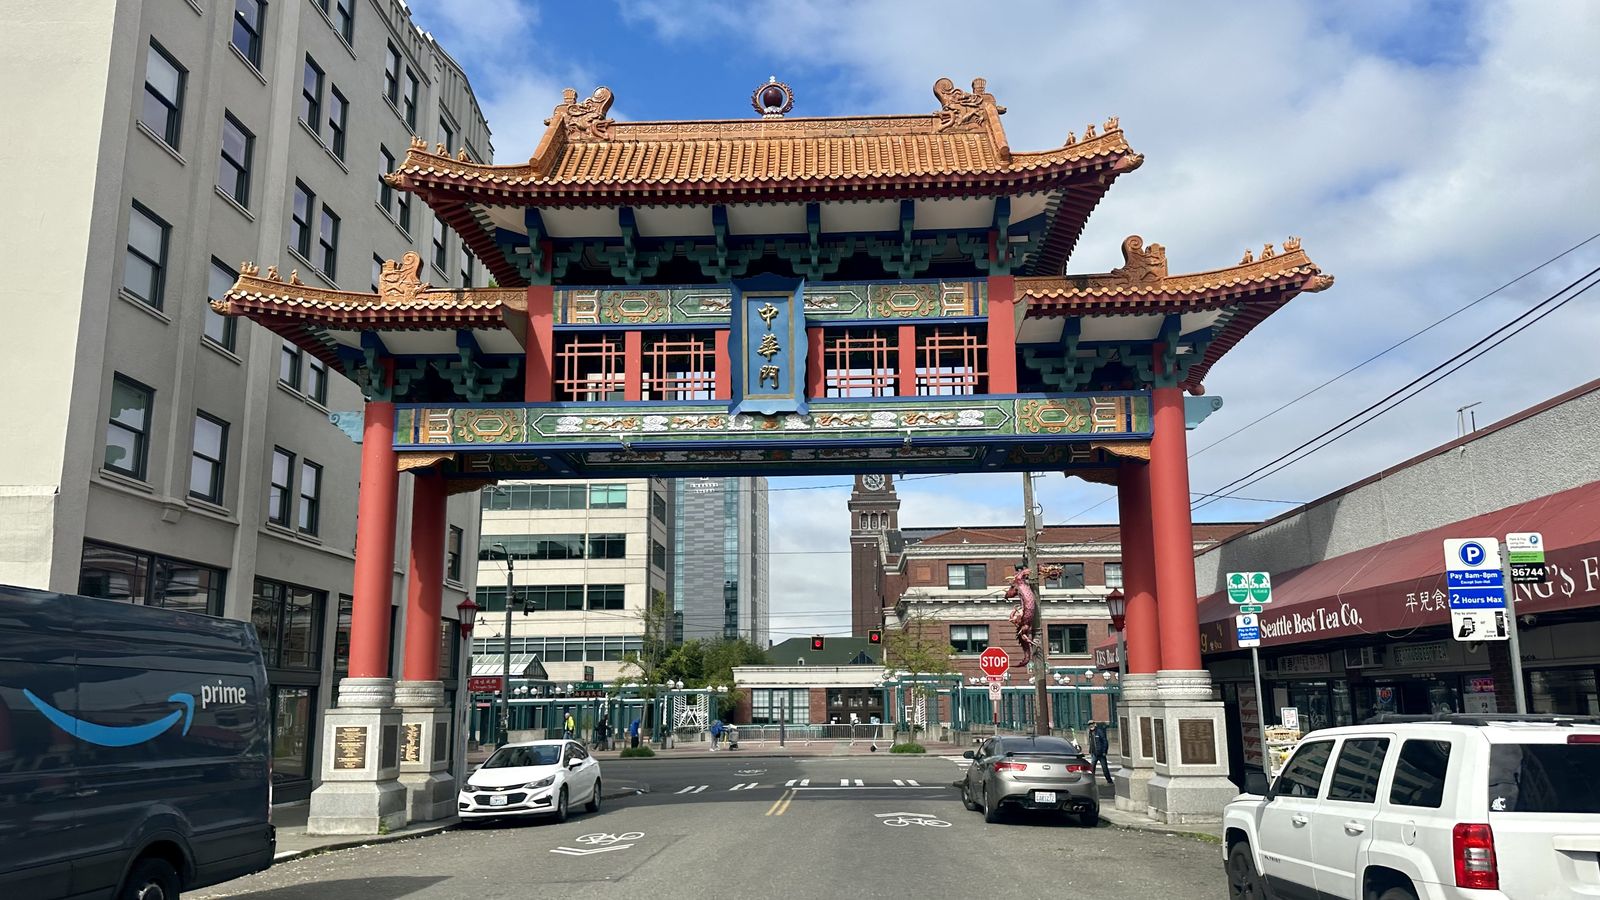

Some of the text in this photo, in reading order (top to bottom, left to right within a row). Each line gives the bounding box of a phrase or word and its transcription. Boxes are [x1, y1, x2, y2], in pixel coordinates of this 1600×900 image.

[757, 302, 781, 390] 中華門
[1512, 568, 1543, 576] 86744
[1406, 588, 1451, 612] 平兒食
[1453, 594, 1460, 604] 2
[1260, 603, 1363, 639] Seattle Best Tea Co.
[982, 656, 1007, 667] STOP
[201, 680, 246, 709] prime
